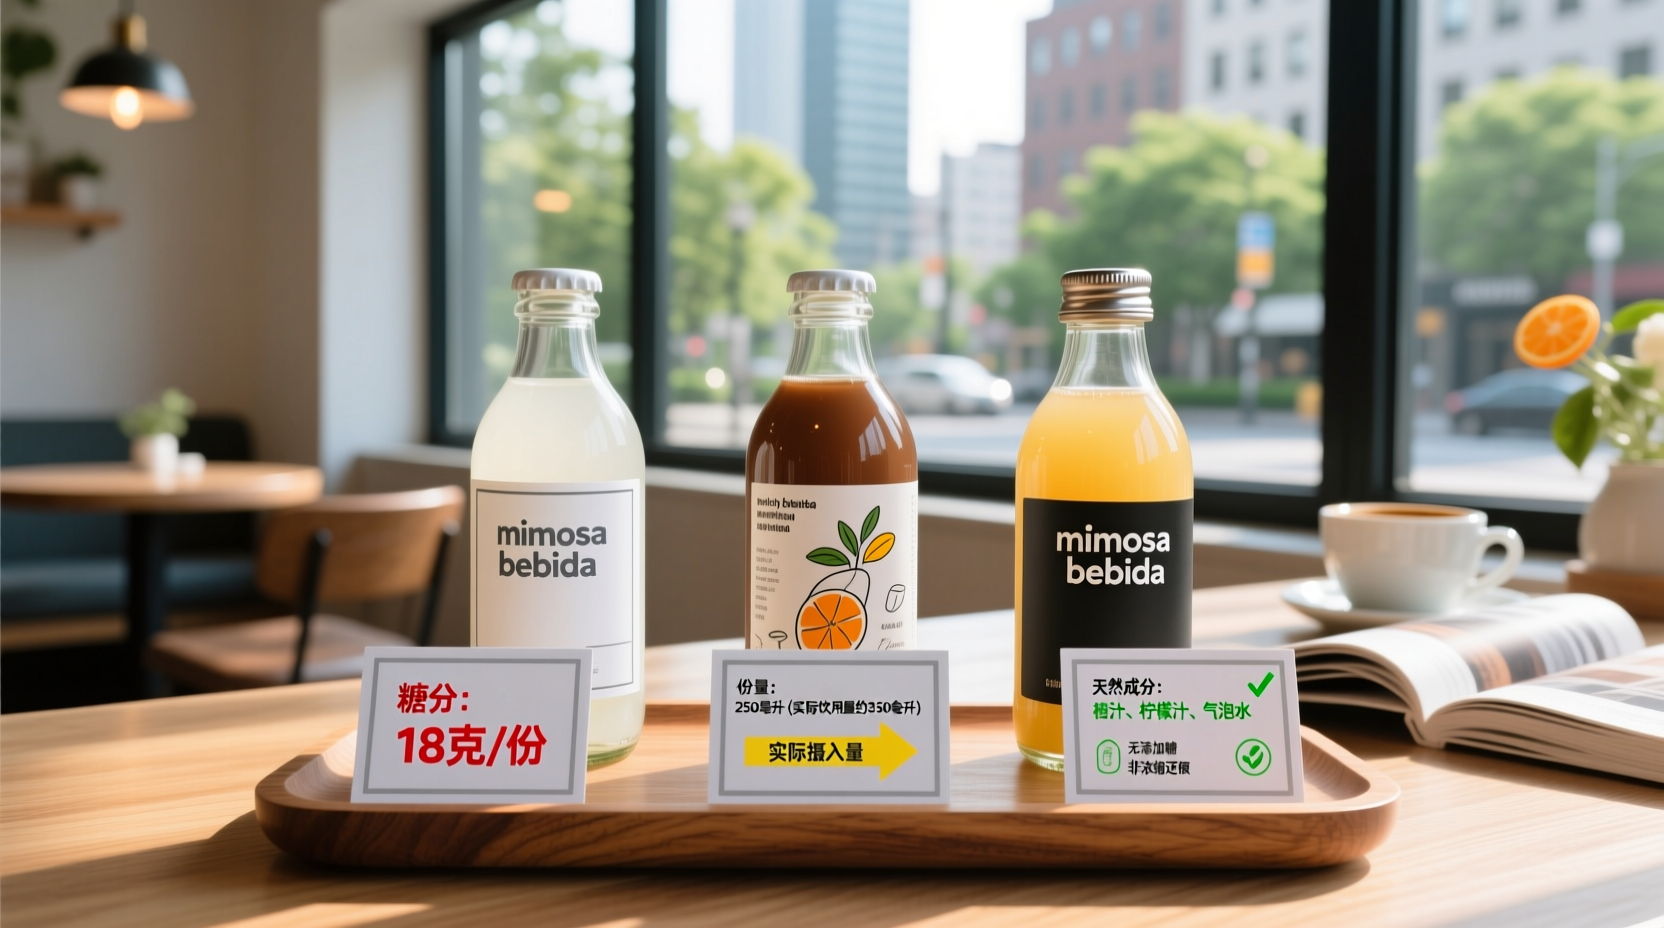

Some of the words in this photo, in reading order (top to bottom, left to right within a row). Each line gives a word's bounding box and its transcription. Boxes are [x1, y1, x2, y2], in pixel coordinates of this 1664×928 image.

[497, 519, 607, 546] mimosa
[1056, 524, 1171, 553] mimosa
[499, 550, 597, 578] bebida
[1066, 555, 1165, 585] bebida
[397, 682, 469, 714] 糖分：
[397, 723, 548, 767] 18克/份
